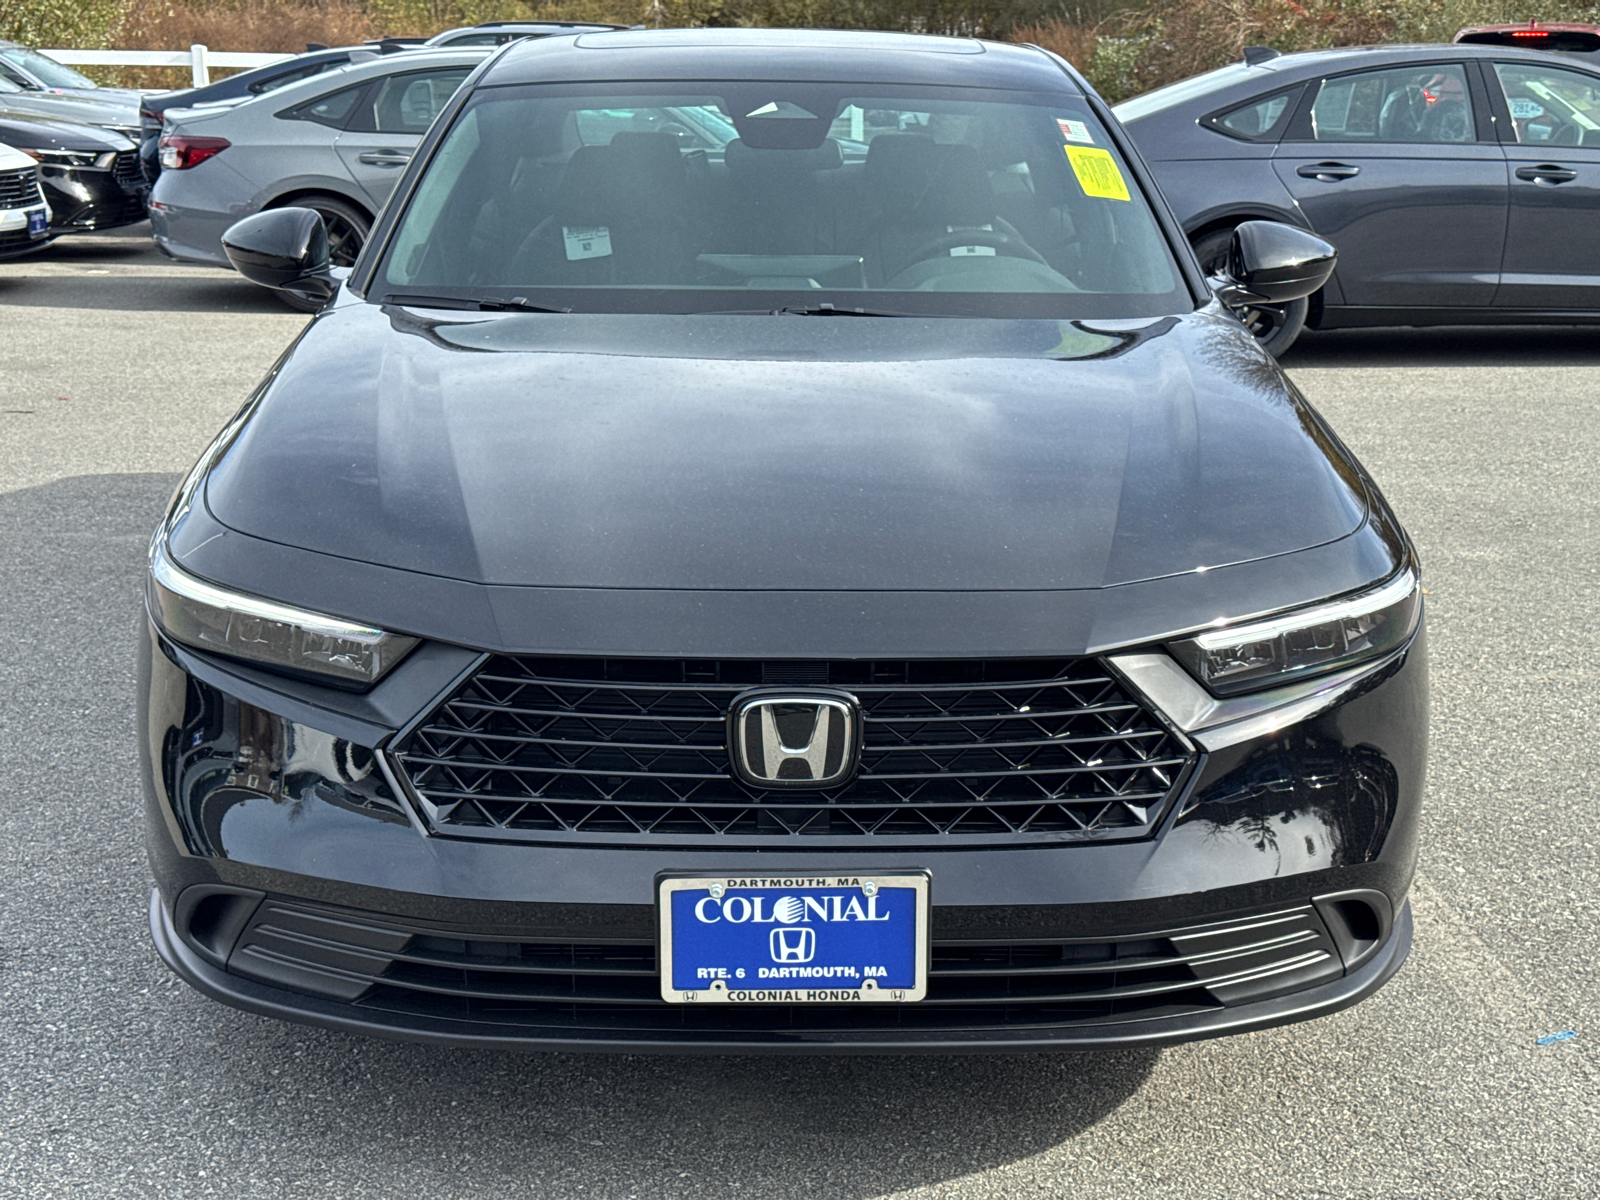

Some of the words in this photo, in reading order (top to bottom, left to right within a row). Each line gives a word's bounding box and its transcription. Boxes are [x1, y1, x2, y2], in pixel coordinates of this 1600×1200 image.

[727, 878, 831, 887] DARTMOUTH,
[837, 878, 861, 886] MA
[694, 896, 890, 924] COLONIAL
[697, 968, 732, 979] RTE.
[735, 968, 746, 979] 6
[758, 967, 860, 979] DARTMOUTH,
[864, 966, 888, 977] MA
[727, 991, 802, 1001] COLONIAL
[807, 990, 861, 1001] HONDA
